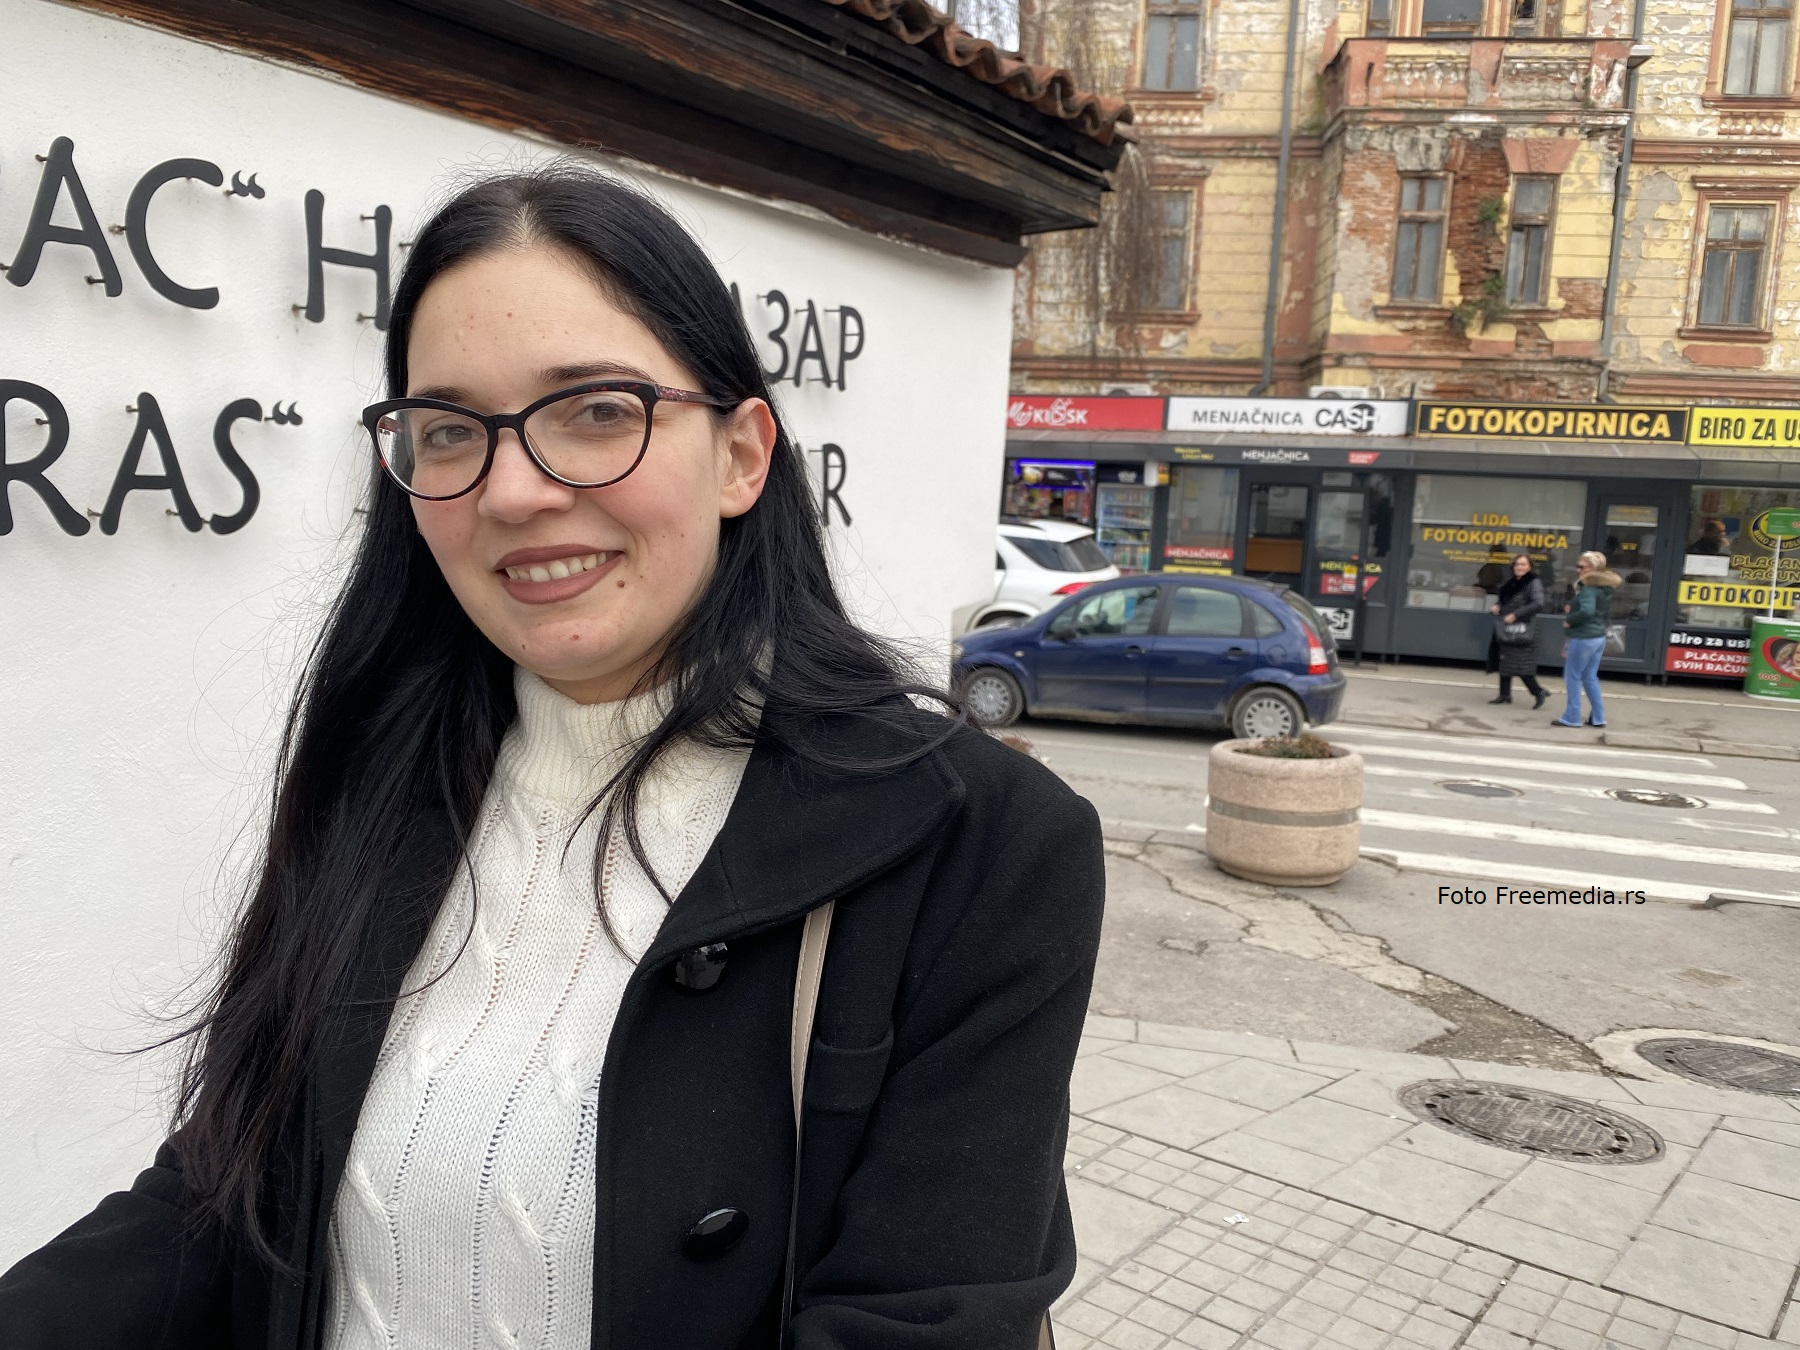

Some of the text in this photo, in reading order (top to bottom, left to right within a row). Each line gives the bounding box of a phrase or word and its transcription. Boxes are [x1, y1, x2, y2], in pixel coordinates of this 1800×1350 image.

[3, 136, 265, 309] АС“
[305, 189, 392, 332] Н
[1193, 403, 1376, 433] MENJAČNICA CASH
[1428, 407, 1671, 438] FOTOKOPIRNICA
[1700, 417, 1800, 441] BIRO ZA U
[1241, 448, 1309, 461] MENJAČNICA
[1472, 513, 1511, 527] LIDA
[1423, 528, 1568, 549] FOTOKOPIRNICA
[1167, 548, 1229, 559] MENJAČNICA
[1670, 632, 1702, 645] Biro
[1705, 637, 1723, 647] za
[1673, 660, 1702, 670] SVIH
[1684, 651, 1751, 664] PLAĆANJE
